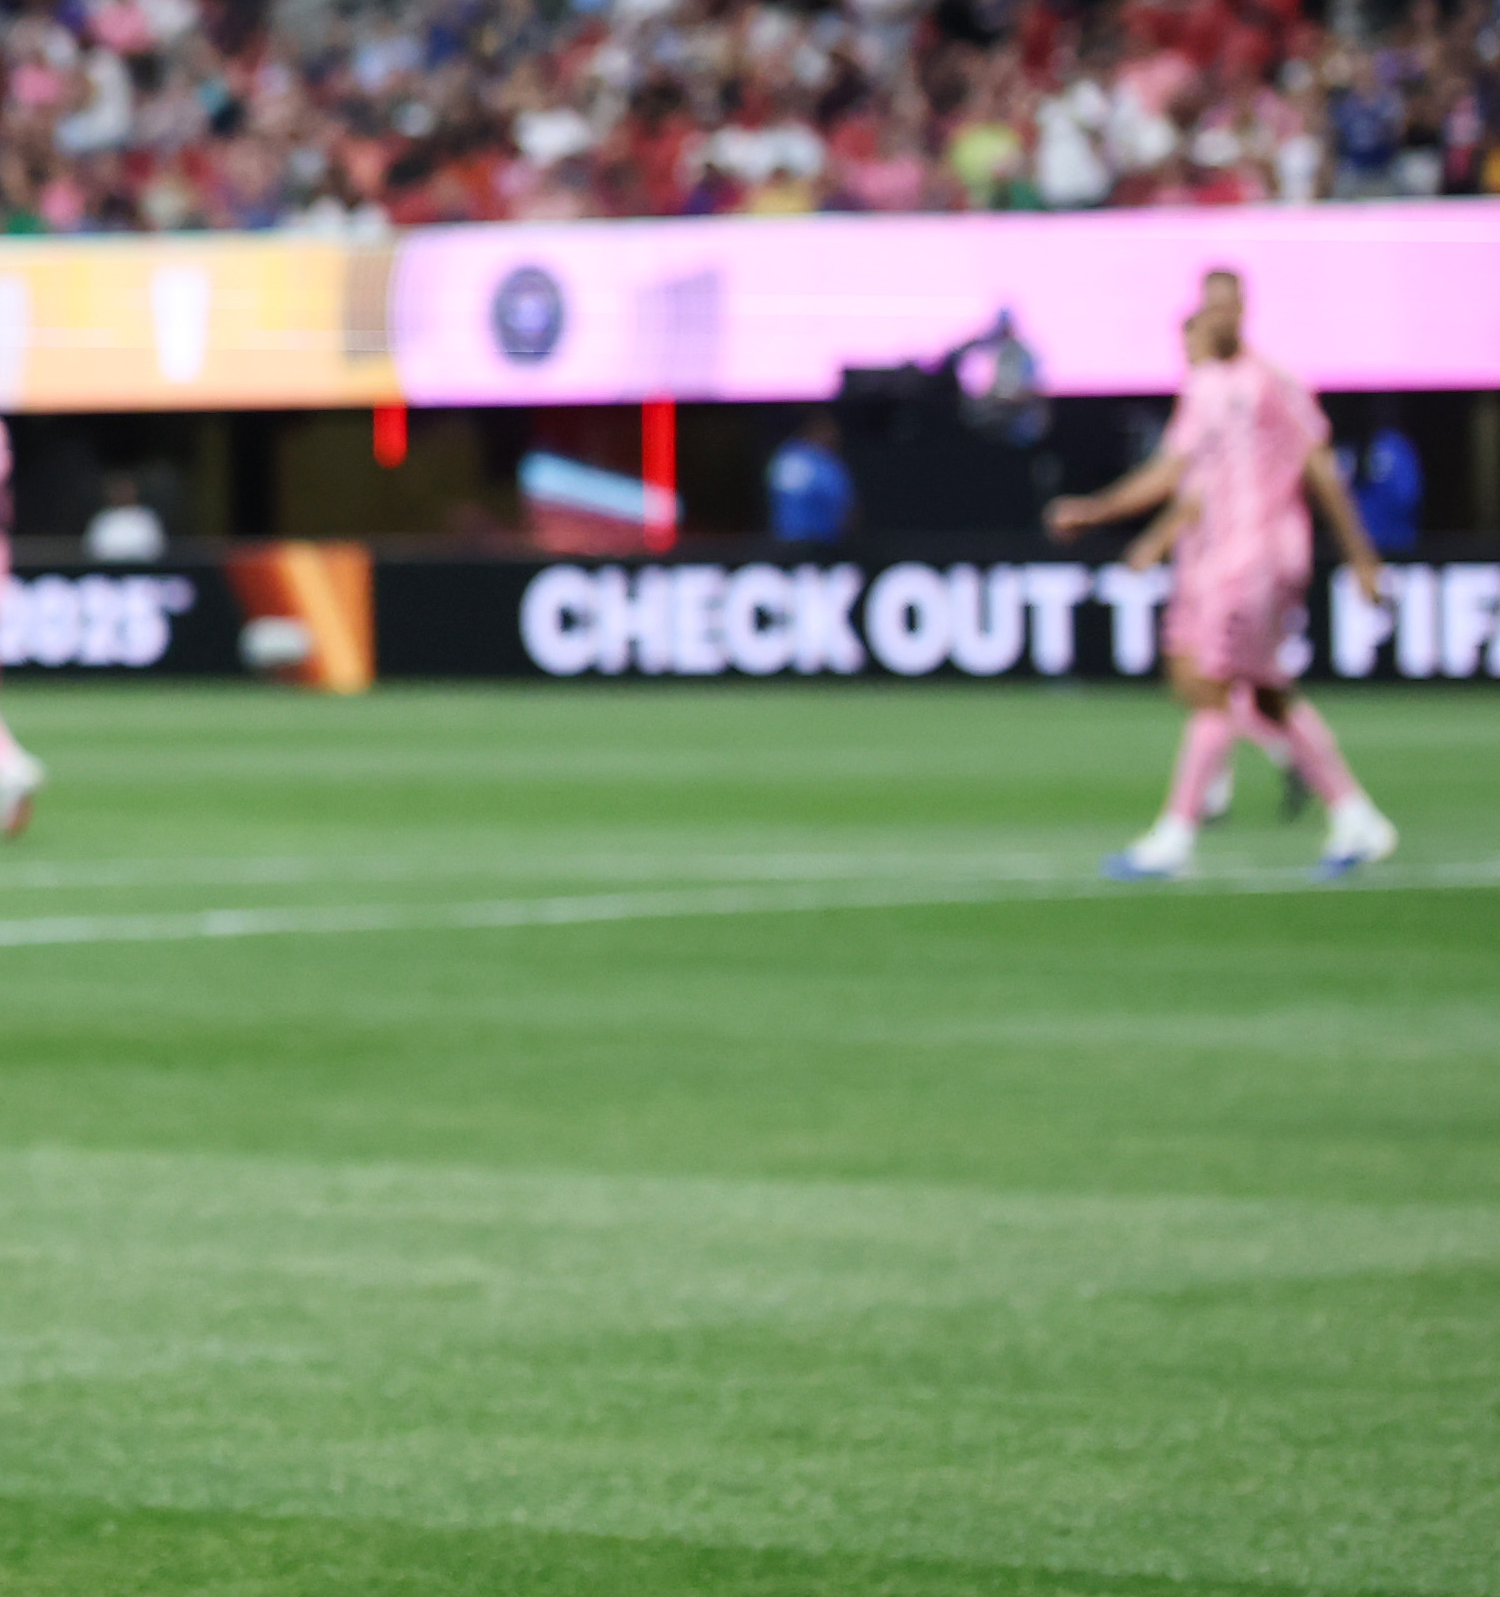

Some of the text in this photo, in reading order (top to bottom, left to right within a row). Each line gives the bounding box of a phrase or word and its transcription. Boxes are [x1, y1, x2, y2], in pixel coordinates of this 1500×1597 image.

[520, 562, 866, 676] CHECK
[866, 561, 1091, 676] OUT
[1330, 563, 1500, 678] FIF
